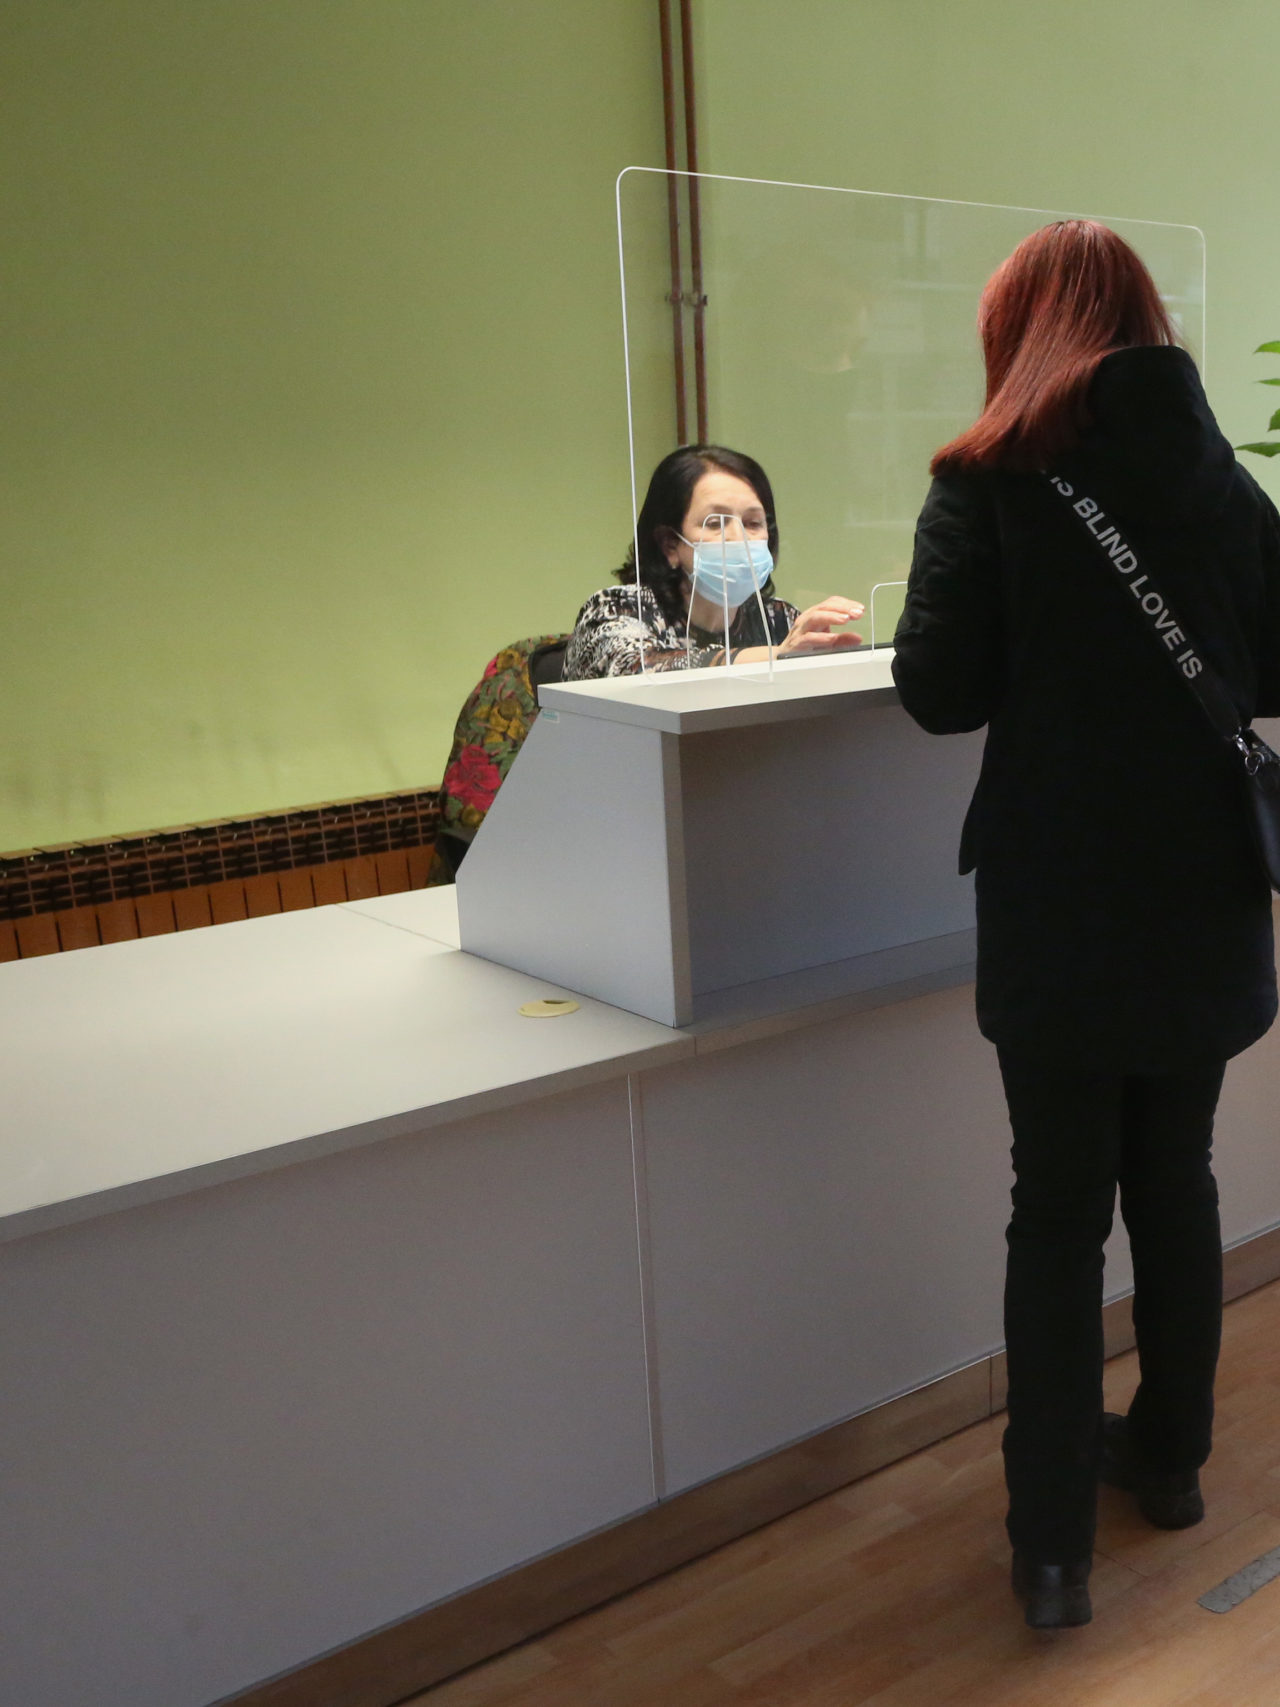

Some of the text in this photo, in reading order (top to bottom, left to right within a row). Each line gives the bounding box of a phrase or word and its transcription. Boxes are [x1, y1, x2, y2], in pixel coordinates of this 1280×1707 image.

[1072, 497, 1138, 574] BLIND
[1129, 574, 1187, 651] LOVE
[1176, 649, 1203, 679] IS
